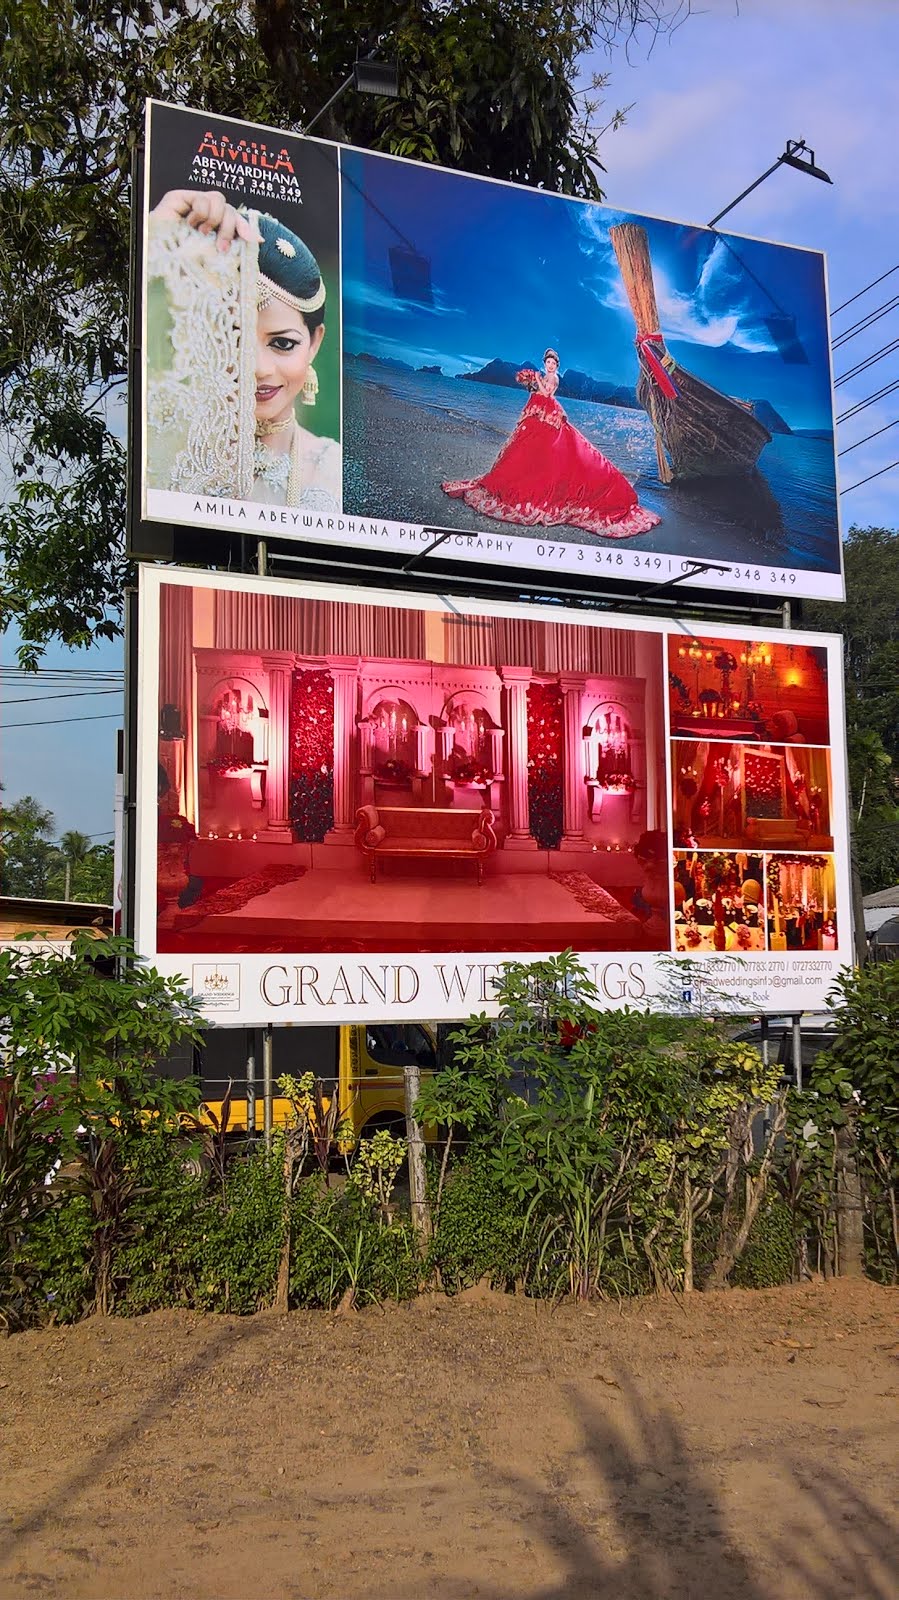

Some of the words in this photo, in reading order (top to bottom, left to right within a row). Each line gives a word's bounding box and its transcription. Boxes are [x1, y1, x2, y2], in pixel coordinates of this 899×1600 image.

[198, 131, 295, 173] AMILA
[204, 138, 291, 162] PHOTOGRAPHY
[192, 155, 299, 187] ABEYWARDHANA
[193, 168, 216, 179] +94
[222, 173, 244, 185] 773
[251, 179, 273, 191] 348
[280, 185, 302, 198] 349
[188, 175, 240, 191] AVISSAWELLA
[250, 188, 303, 204] MAHARAGAMA
[193, 501, 247, 518] AMILA
[258, 510, 390, 536] ABEYWARDHANA
[537, 544, 566, 558] 077
[577, 550, 584, 560] 3
[595, 551, 623, 565] 348
[633, 555, 661, 569] 349
[735, 568, 760, 581] 348
[771, 572, 796, 584] 349
[792, 961, 832, 972] 0727332770
[259, 964, 420, 1007] GRAND
[752, 991, 769, 1001] Book
